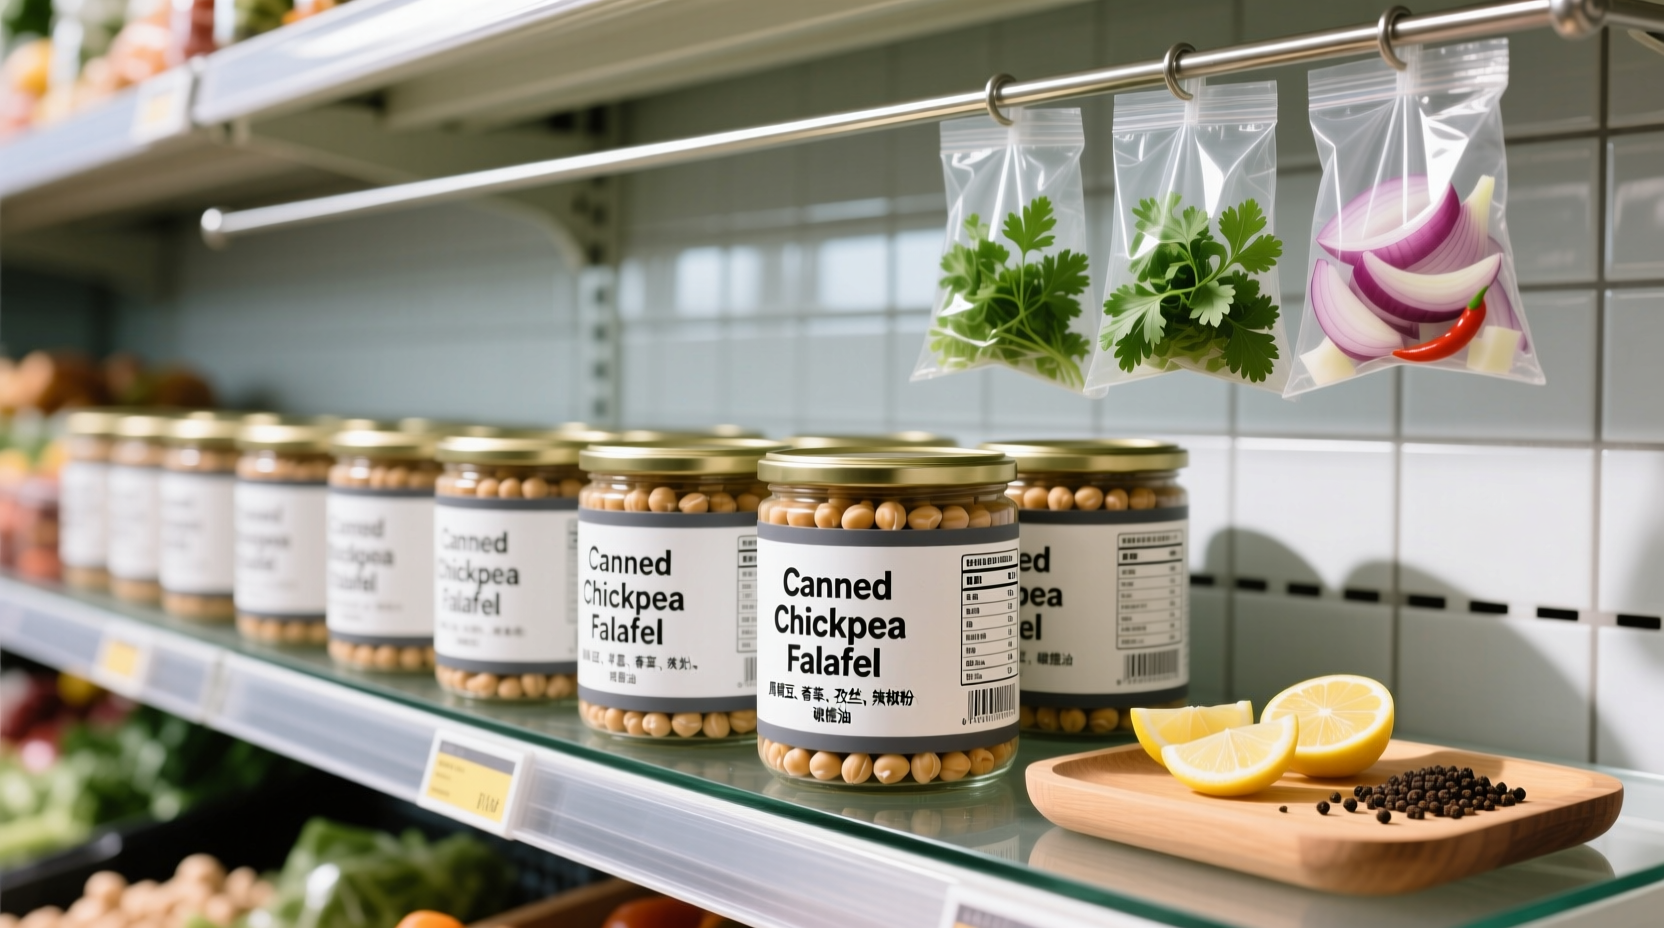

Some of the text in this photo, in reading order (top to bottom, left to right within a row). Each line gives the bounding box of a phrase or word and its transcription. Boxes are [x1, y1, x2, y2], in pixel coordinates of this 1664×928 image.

[588, 545, 672, 577] Canned
[583, 578, 685, 616] Chickpea
[783, 566, 892, 601] Canned
[591, 612, 664, 646] Falafel
[774, 603, 907, 646] Chickpea
[787, 643, 881, 678] Falafel
